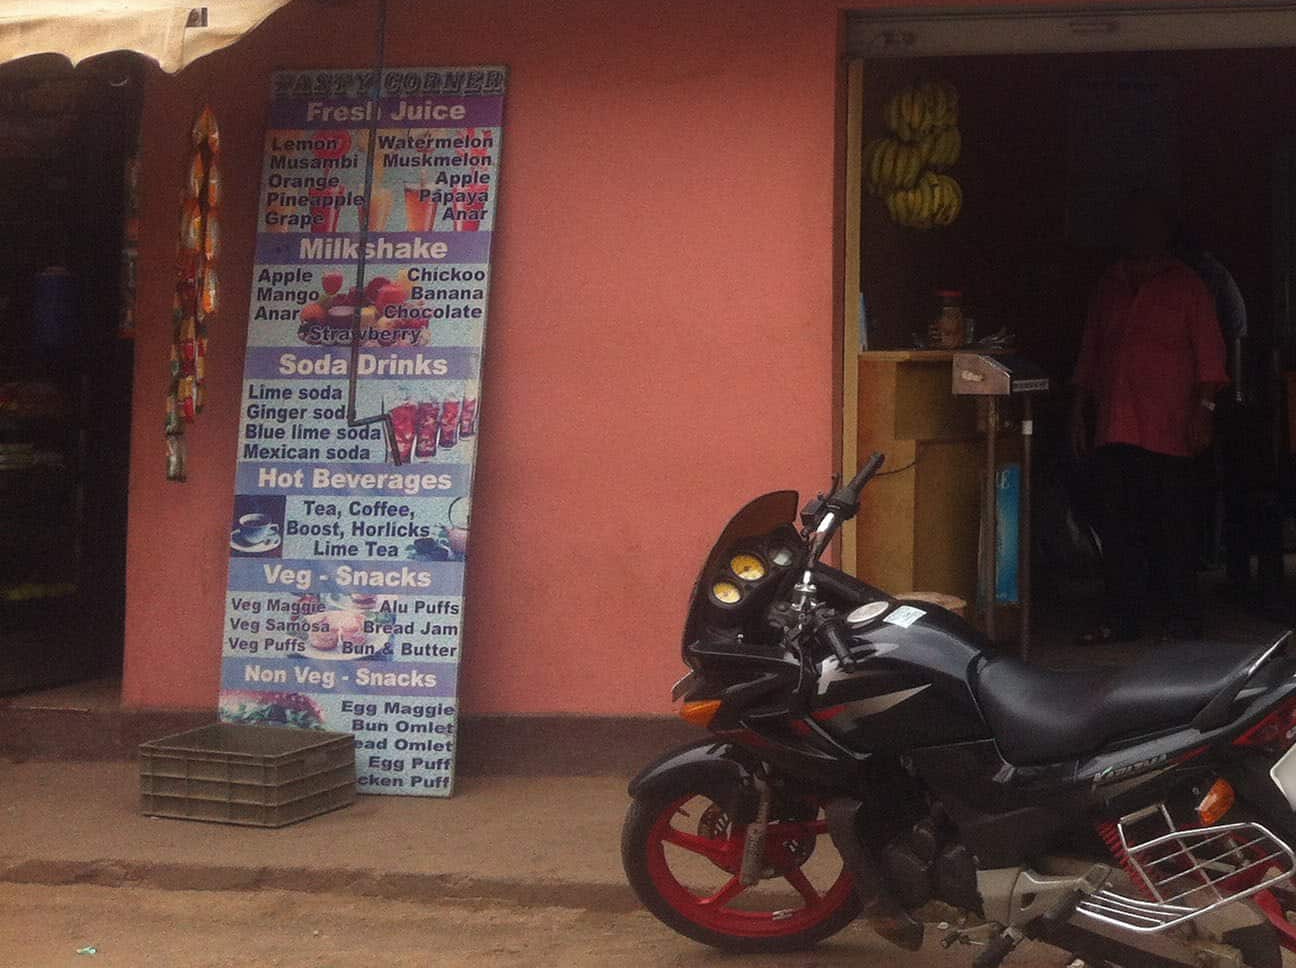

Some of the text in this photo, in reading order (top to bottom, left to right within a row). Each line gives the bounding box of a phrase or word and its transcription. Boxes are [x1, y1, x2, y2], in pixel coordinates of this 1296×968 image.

[383, 70, 503, 95] CORNER
[391, 101, 466, 120] Juice
[272, 137, 338, 151] Lemon
[377, 135, 494, 150] Watermelon
[270, 154, 358, 169] Musambi
[382, 153, 492, 168] Muskmelon
[268, 174, 339, 190] Orange
[435, 171, 490, 187] Apple
[266, 191, 365, 208] Pineapple
[419, 190, 489, 206] Papaya
[264, 212, 324, 228] Grape
[442, 208, 488, 222] Anar
[300, 237, 448, 260] Milkshake
[258, 269, 313, 285] Apple
[407, 267, 486, 282] Chickoo
[256, 288, 319, 304] Mango
[410, 286, 484, 301] Banana
[254, 306, 299, 321] Anar
[384, 305, 482, 320] Chocolate
[309, 325, 421, 344] Strawberry
[279, 353, 448, 376] Soda Drinks
[248, 384, 342, 401] Lime soda
[246, 404, 356, 422] Ginger sod
[244, 423, 381, 440] Blue lime soda
[243, 445, 370, 461] Mexican soda
[258, 468, 452, 494] Hot Beverages
[303, 500, 416, 519] Tea, Coffee,
[287, 522, 430, 539] Boost, Horlicks
[313, 541, 399, 557] Lime Tea
[264, 564, 311, 589] Veg
[336, 566, 432, 587] Snacks
[231, 598, 326, 616] Veg Maggie
[380, 600, 460, 616] Alu Puffs
[229, 618, 331, 634] Veg Samosa
[363, 620, 458, 636] Bread Jam
[228, 637, 306, 653] Veg Puffs
[342, 641, 457, 657] Bun & Butter
[245, 665, 287, 682] Non
[295, 666, 336, 688] Veg
[355, 668, 437, 688] Snacks
[341, 700, 455, 718] Egg Maggie
[351, 720, 455, 735] Bun Omlet
[352, 738, 453, 753] ead Omlet
[368, 756, 404, 772] Egg
[357, 774, 404, 789] cken
